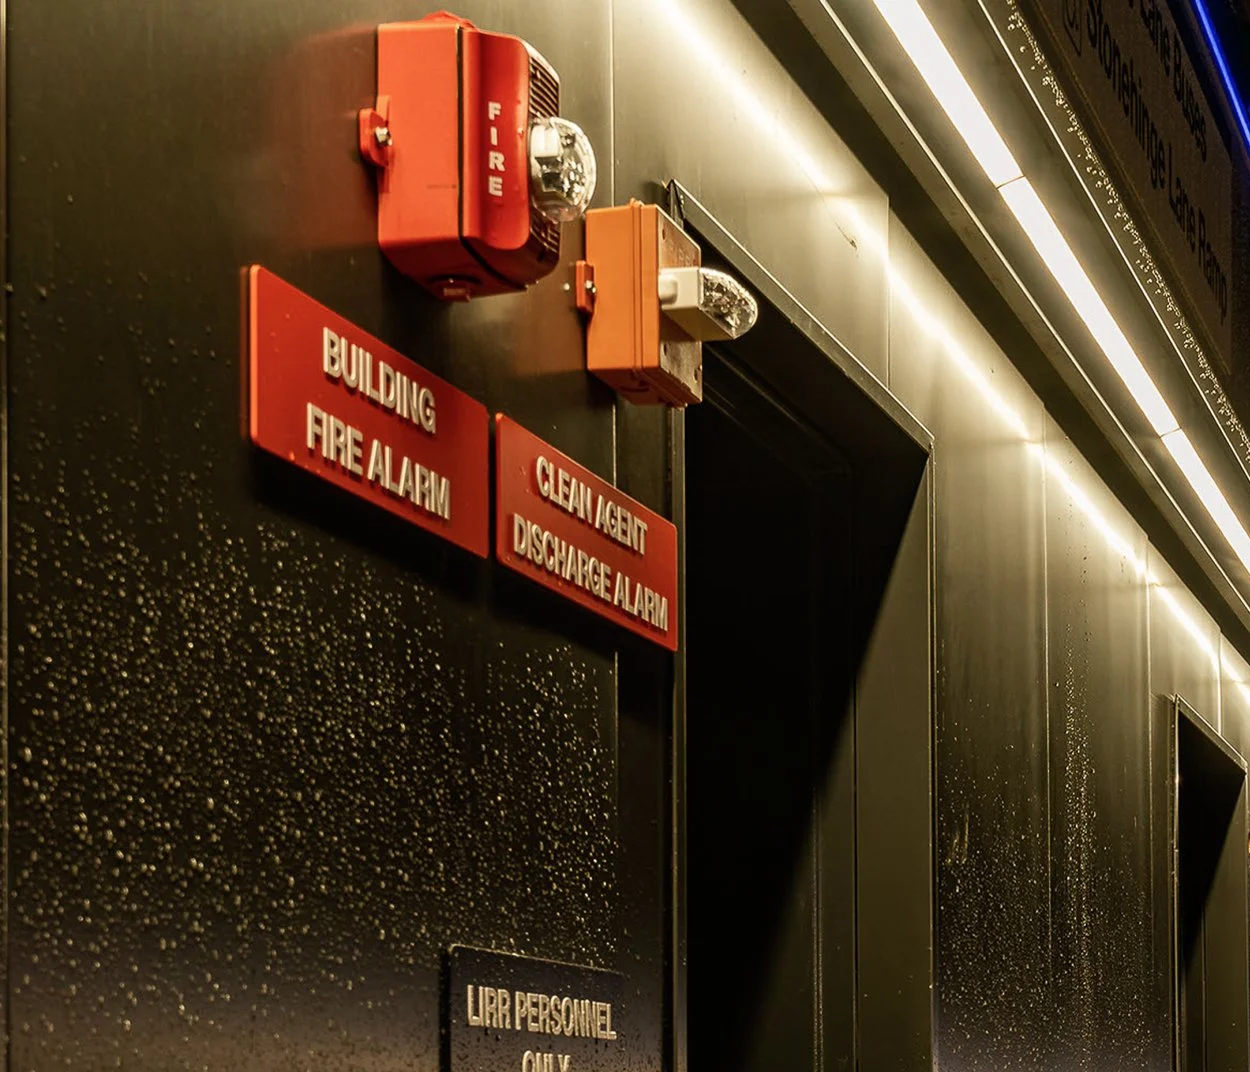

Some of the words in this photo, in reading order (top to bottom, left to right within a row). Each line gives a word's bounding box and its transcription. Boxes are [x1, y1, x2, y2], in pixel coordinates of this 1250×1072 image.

[487, 102, 503, 197] FIRE
[1173, 30, 1207, 162] Buses
[1087, 0, 1165, 189] Stonehinge
[1168, 142, 1196, 251] Lane
[1198, 208, 1228, 325] Ramp
[322, 327, 436, 435] BUILDING
[306, 402, 363, 475] FIRE
[366, 440, 451, 520] ALARM
[535, 455, 592, 524] CLEAN
[594, 491, 648, 555] AGENT
[513, 513, 611, 599] DISCHARGE
[613, 575, 668, 631] ALARM
[467, 984, 512, 1030] LIRR
[514, 993, 618, 1040] PERSONNEL
